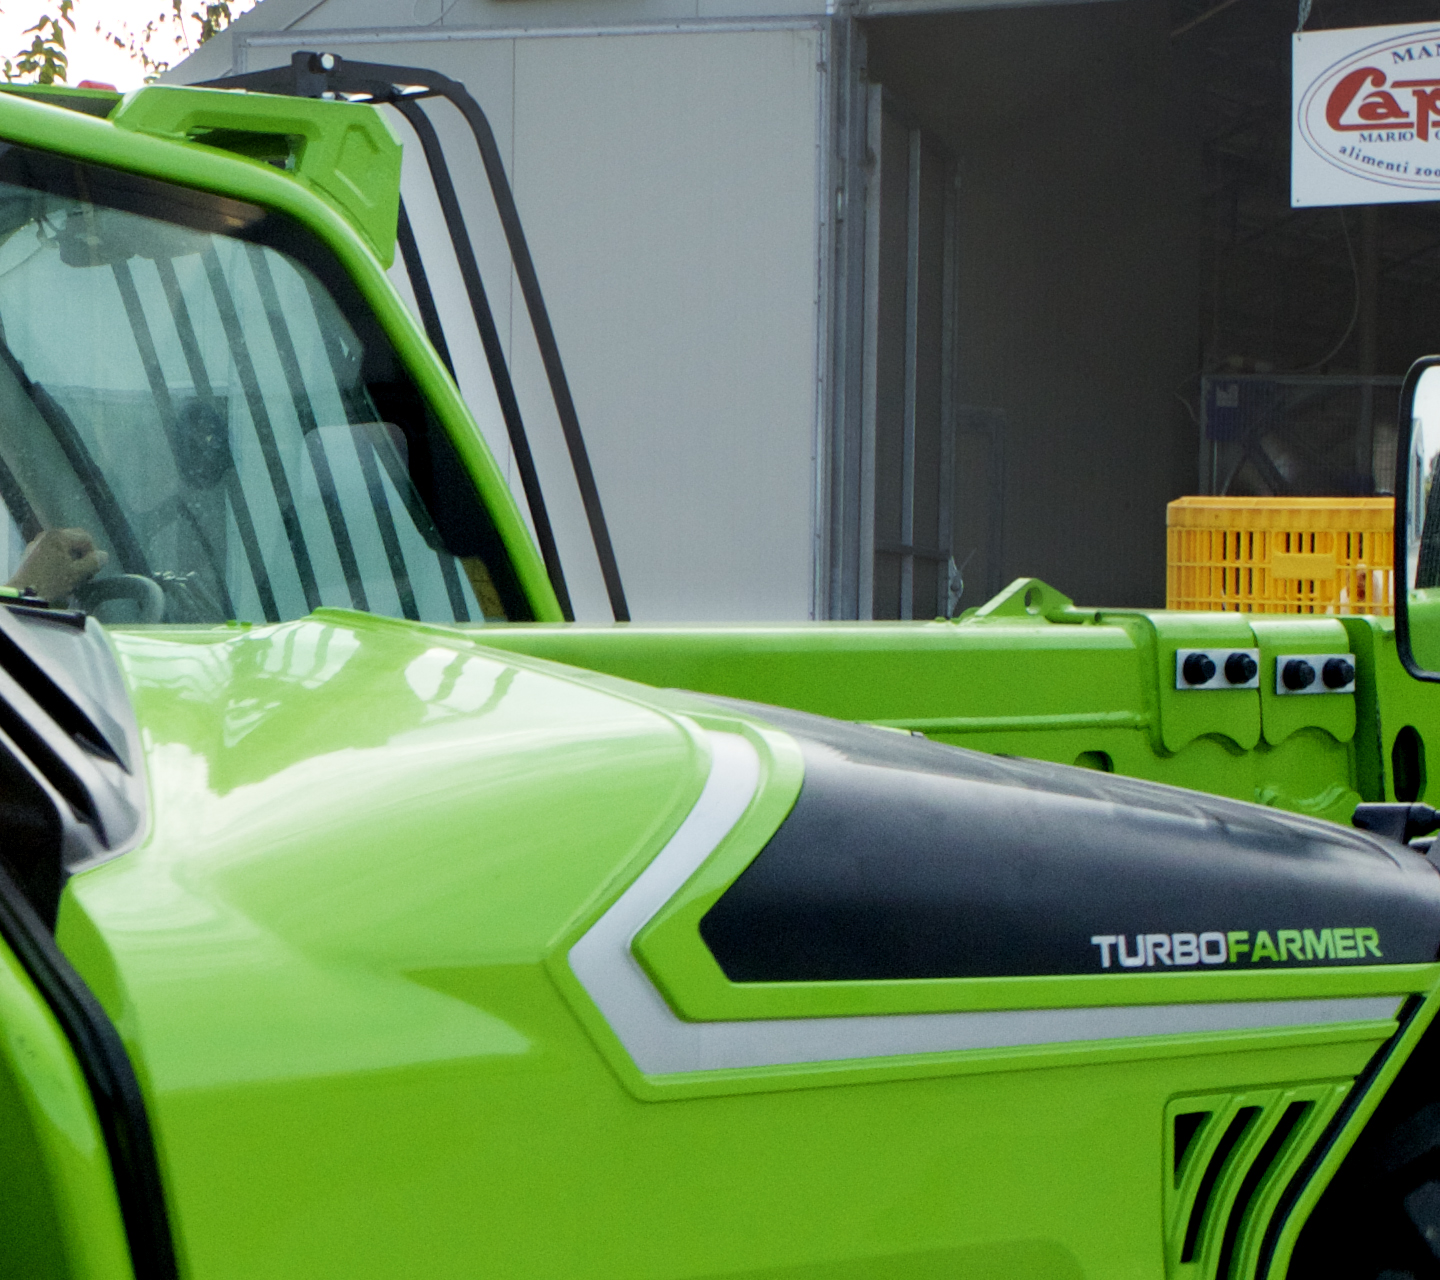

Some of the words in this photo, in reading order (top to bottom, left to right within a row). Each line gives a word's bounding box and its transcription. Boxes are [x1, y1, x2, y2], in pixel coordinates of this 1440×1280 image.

[1358, 130, 1414, 143] MARIO
[1338, 143, 1410, 175] alimenti
[1090, 926, 1383, 969] TURBOFARMER
